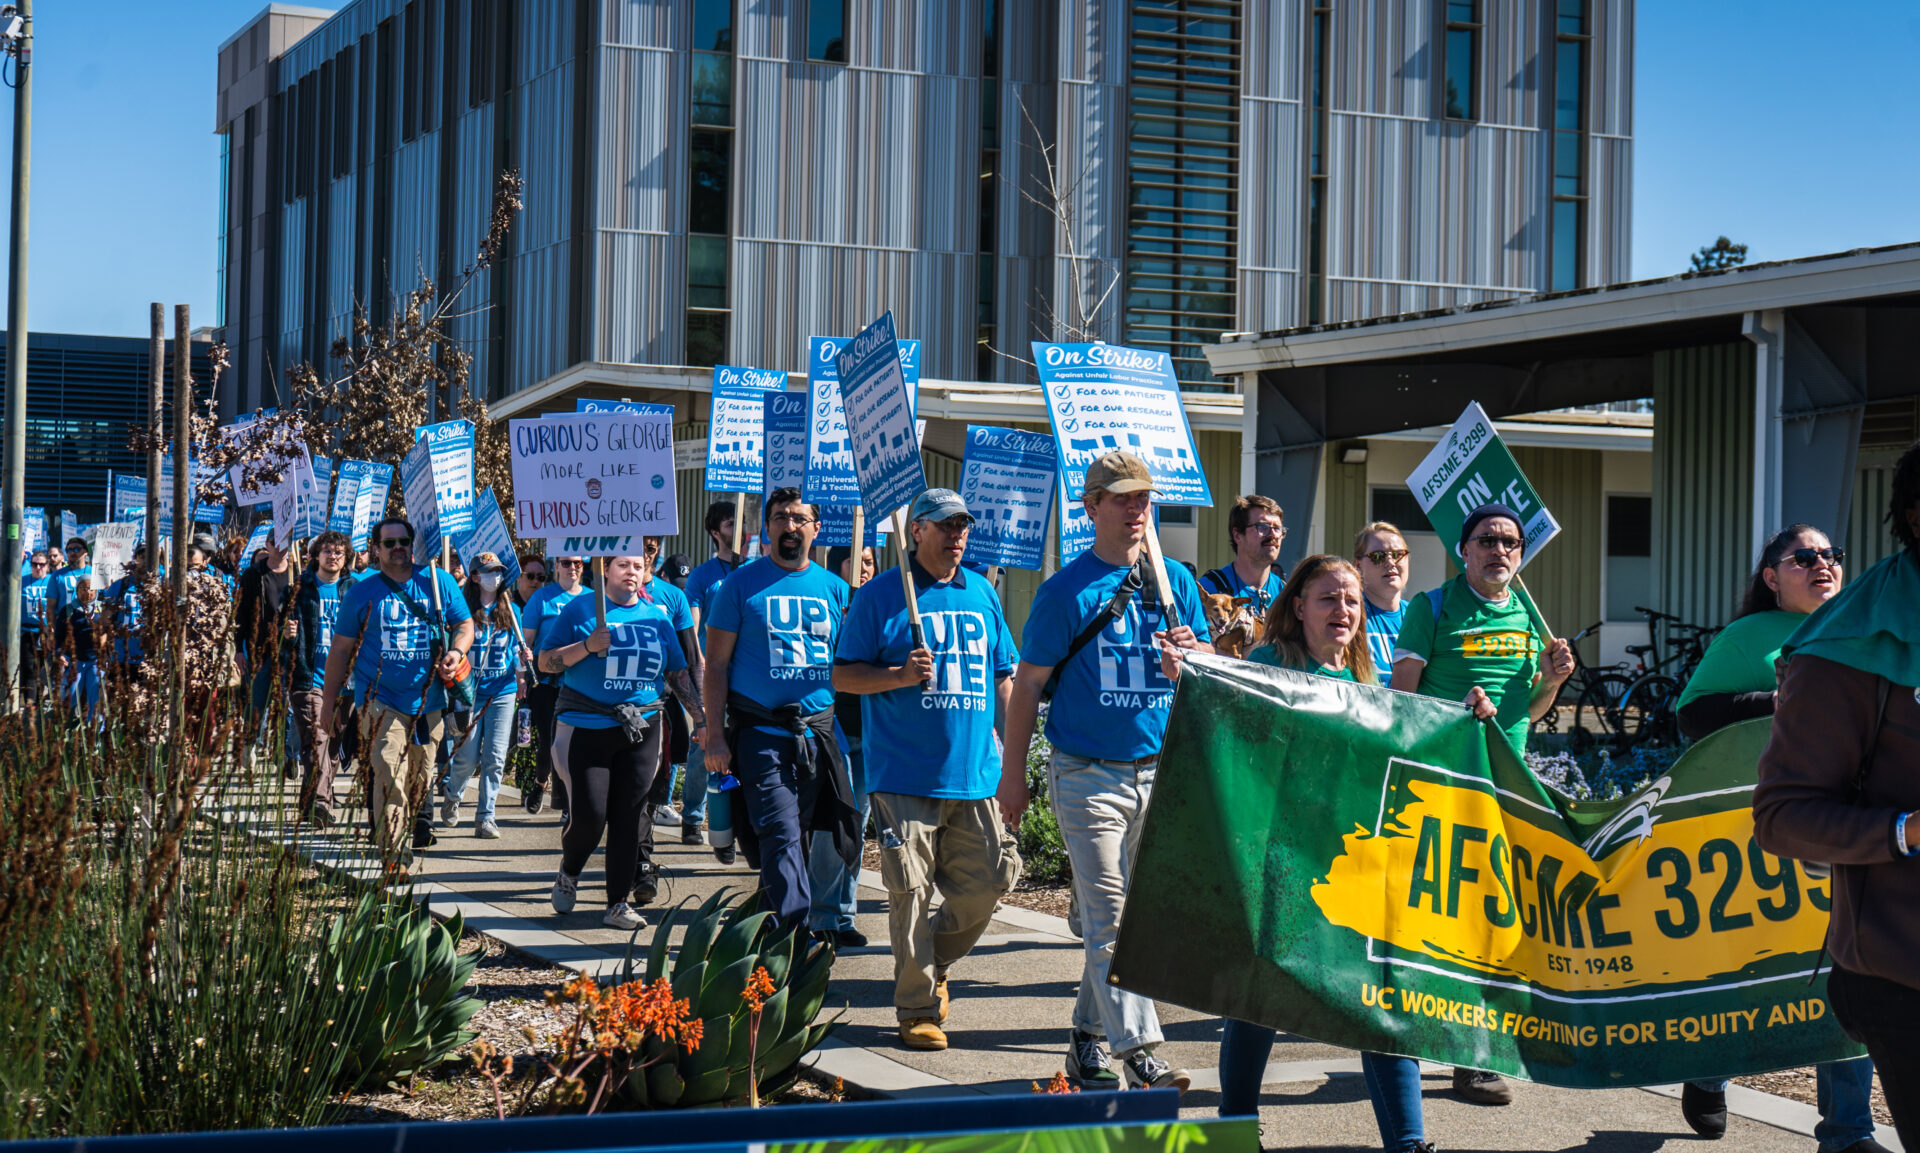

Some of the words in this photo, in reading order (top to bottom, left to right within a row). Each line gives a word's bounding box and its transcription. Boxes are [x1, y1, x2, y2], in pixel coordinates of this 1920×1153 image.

[840, 353, 854, 377] On
[854, 314, 890, 363] Strike!
[1046, 346, 1084, 366] On
[1086, 346, 1165, 372] Strike!
[720, 369, 740, 385] On
[740, 370, 785, 388] Strike!
[874, 366, 894, 388] PATIENTS
[1131, 376, 1164, 386] Practices
[876, 384, 899, 406] RESEARCH
[1076, 388, 1098, 396] FOR
[1101, 388, 1121, 396] OUR
[1124, 390, 1167, 400] PATIENTS
[773, 395, 803, 414] On
[1128, 406, 1173, 417] RESEARCH
[880, 402, 902, 426] STUDENTS
[1084, 420, 1106, 429] FOR
[1132, 422, 1176, 432] STUDENTS
[517, 422, 599, 458] CURIOUS
[608, 422, 672, 452] GEORGE
[974, 428, 1000, 446] On
[1001, 433, 1056, 454] Strike!
[344, 463, 358, 472] On
[359, 464, 392, 475] Strike!
[540, 462, 586, 480] MORE
[601, 464, 640, 477] LIKE
[1027, 459, 1051, 467] Practices
[1422, 455, 1463, 502] AFSCME
[1458, 422, 1488, 458] 3299
[822, 476, 858, 484] Universit
[984, 467, 998, 475] FOR
[1016, 472, 1047, 480] PATIENTS
[1152, 474, 1202, 484] ofessional
[1013, 486, 1044, 494] RESEARCH
[1456, 472, 1493, 516] ON
[1010, 499, 1042, 508] STUDENTS
[518, 500, 591, 532] FURIOUS
[597, 499, 668, 526] GEORGE
[98, 526, 134, 539] STUDENTS
[1074, 536, 1096, 544] Univer
[1526, 518, 1548, 549] ACTICE
[564, 536, 632, 552] NOW!
[967, 538, 998, 548] niversity
[1000, 542, 1040, 552] Professional
[970, 544, 1002, 554] Technical
[1003, 549, 1039, 558] Employees
[770, 598, 828, 632] UP
[611, 624, 658, 648] UP
[921, 614, 984, 652] UP
[381, 652, 404, 660] CWA
[408, 651, 430, 660] 9119
[770, 633, 828, 665] TE
[608, 650, 662, 680] TE
[770, 668, 804, 680] CWA
[808, 669, 830, 680] 9119
[931, 653, 985, 693] TE
[604, 680, 632, 690] CWA
[636, 681, 656, 691] 9119
[922, 696, 959, 710] CWA
[964, 698, 986, 712] 9119
[1100, 692, 1142, 708] CWA
[1408, 814, 1632, 950] AFSCME
[1548, 953, 1579, 974] EST.
[1584, 955, 1634, 974] 1948
[1361, 984, 1396, 1010] UC
[1401, 988, 1498, 1031] WORKERS
[1502, 1012, 1598, 1046] FIGHTING
[1606, 1022, 1658, 1046] FOR
[1665, 1008, 1760, 1042] EQUITY
[1767, 998, 1826, 1028] AND
